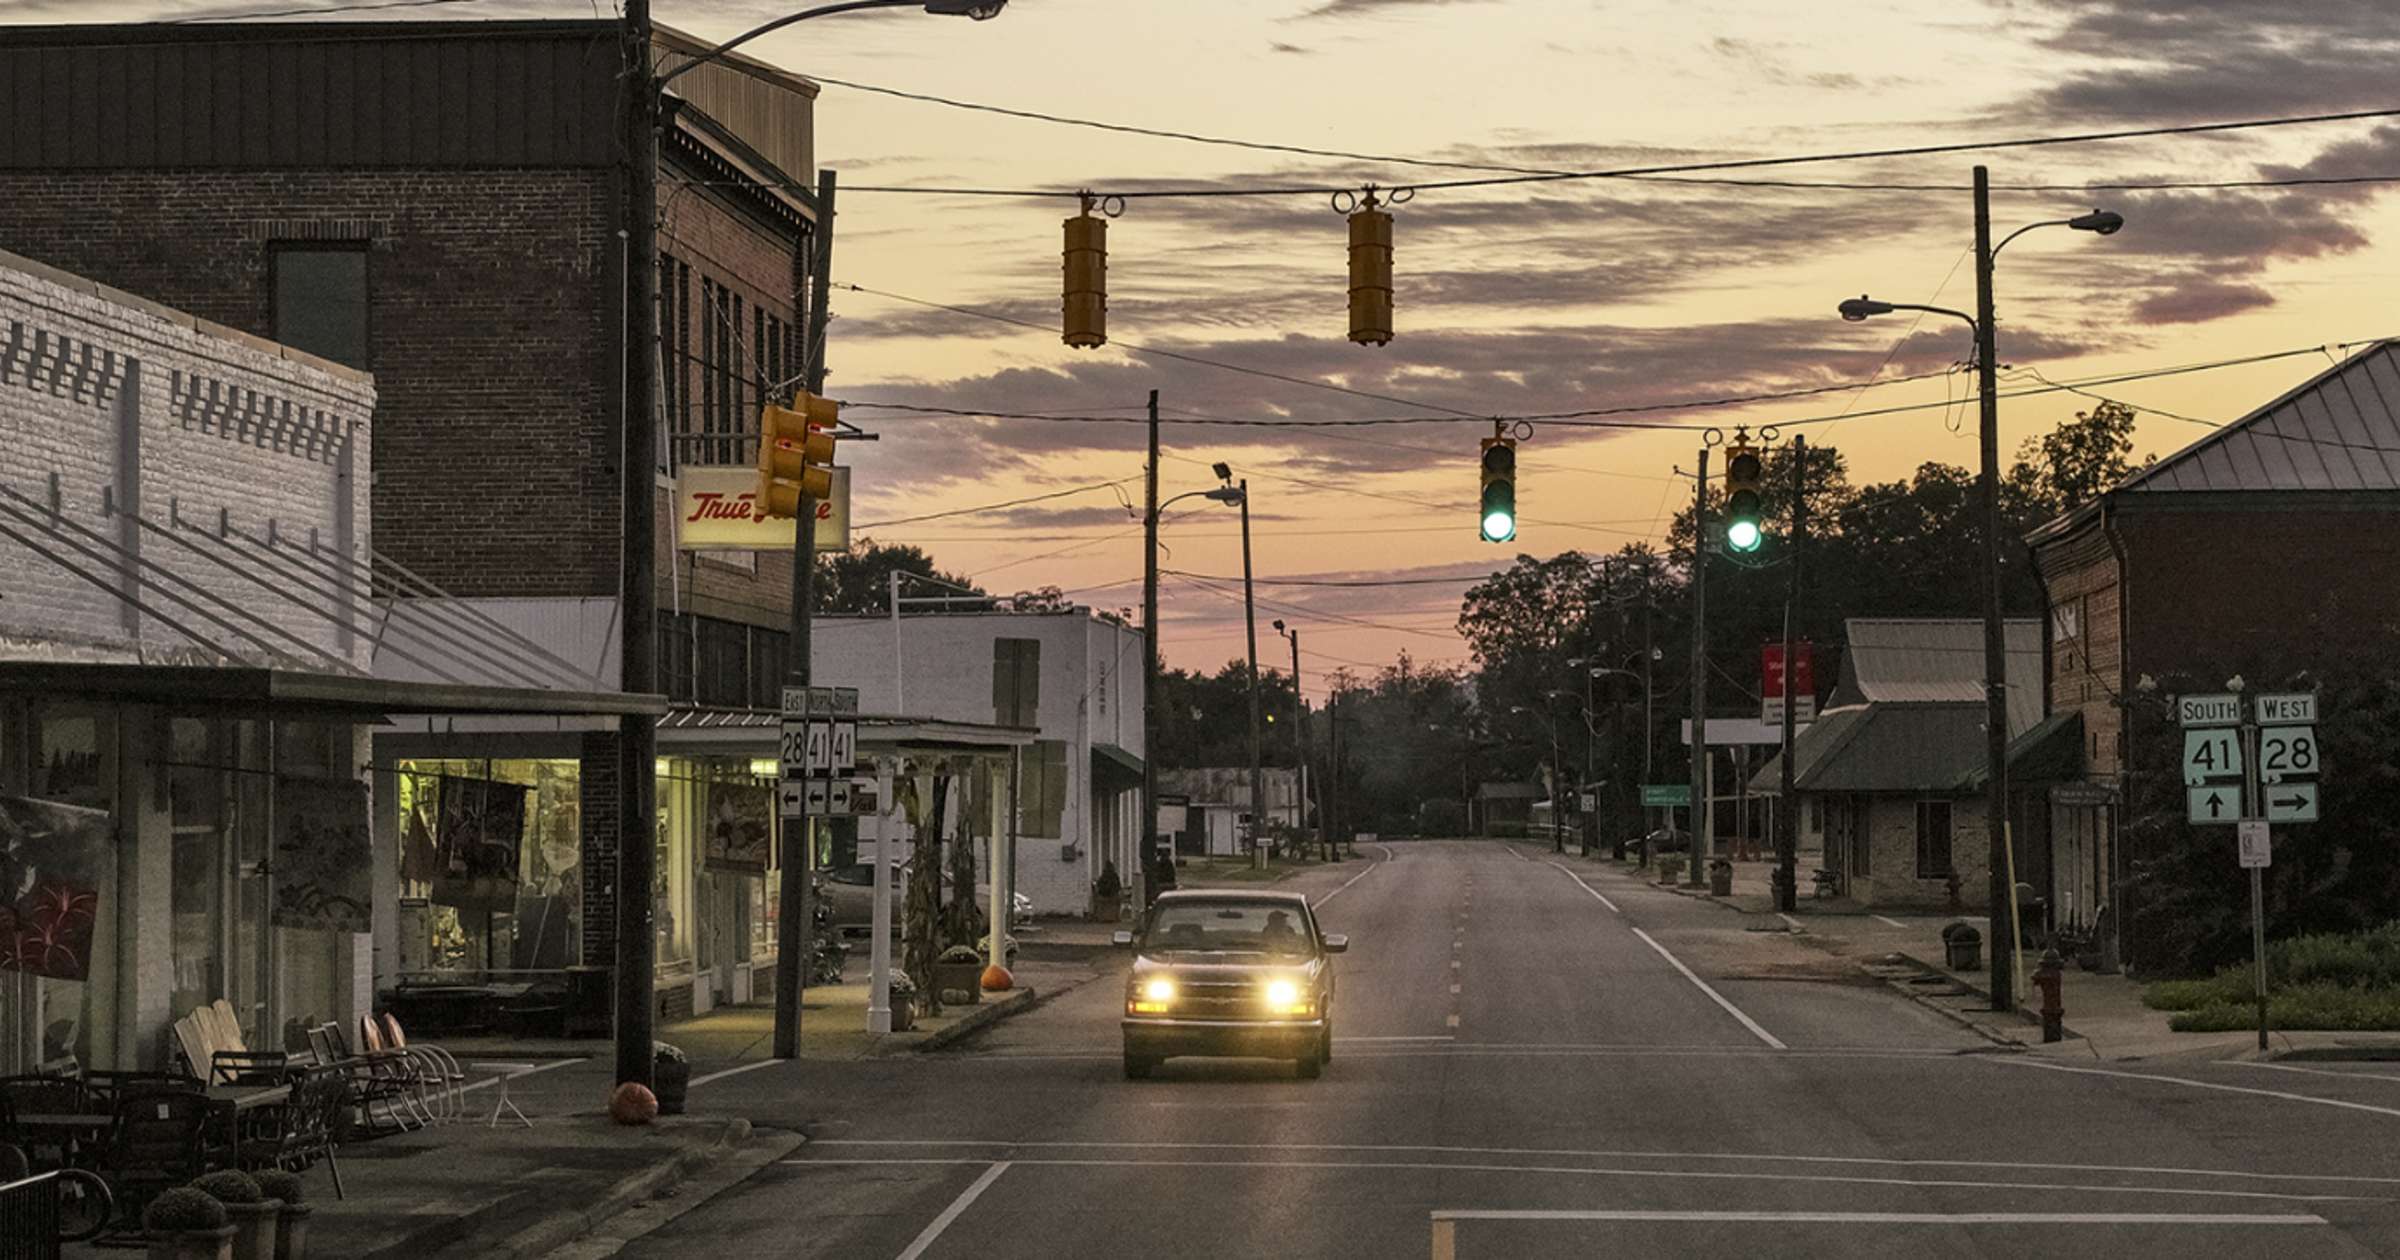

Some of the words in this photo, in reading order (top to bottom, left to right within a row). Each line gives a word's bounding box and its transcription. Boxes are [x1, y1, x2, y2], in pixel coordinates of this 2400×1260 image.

[687, 492, 752, 522] True
[785, 692, 804, 711] EAST
[2183, 701, 2238, 720] SOUTH
[2263, 699, 2309, 718] WEST
[783, 732, 803, 763] 28
[809, 733, 826, 764] 41
[834, 733, 851, 764] 41
[2191, 739, 2230, 770] 41
[2266, 738, 2312, 770] 28
